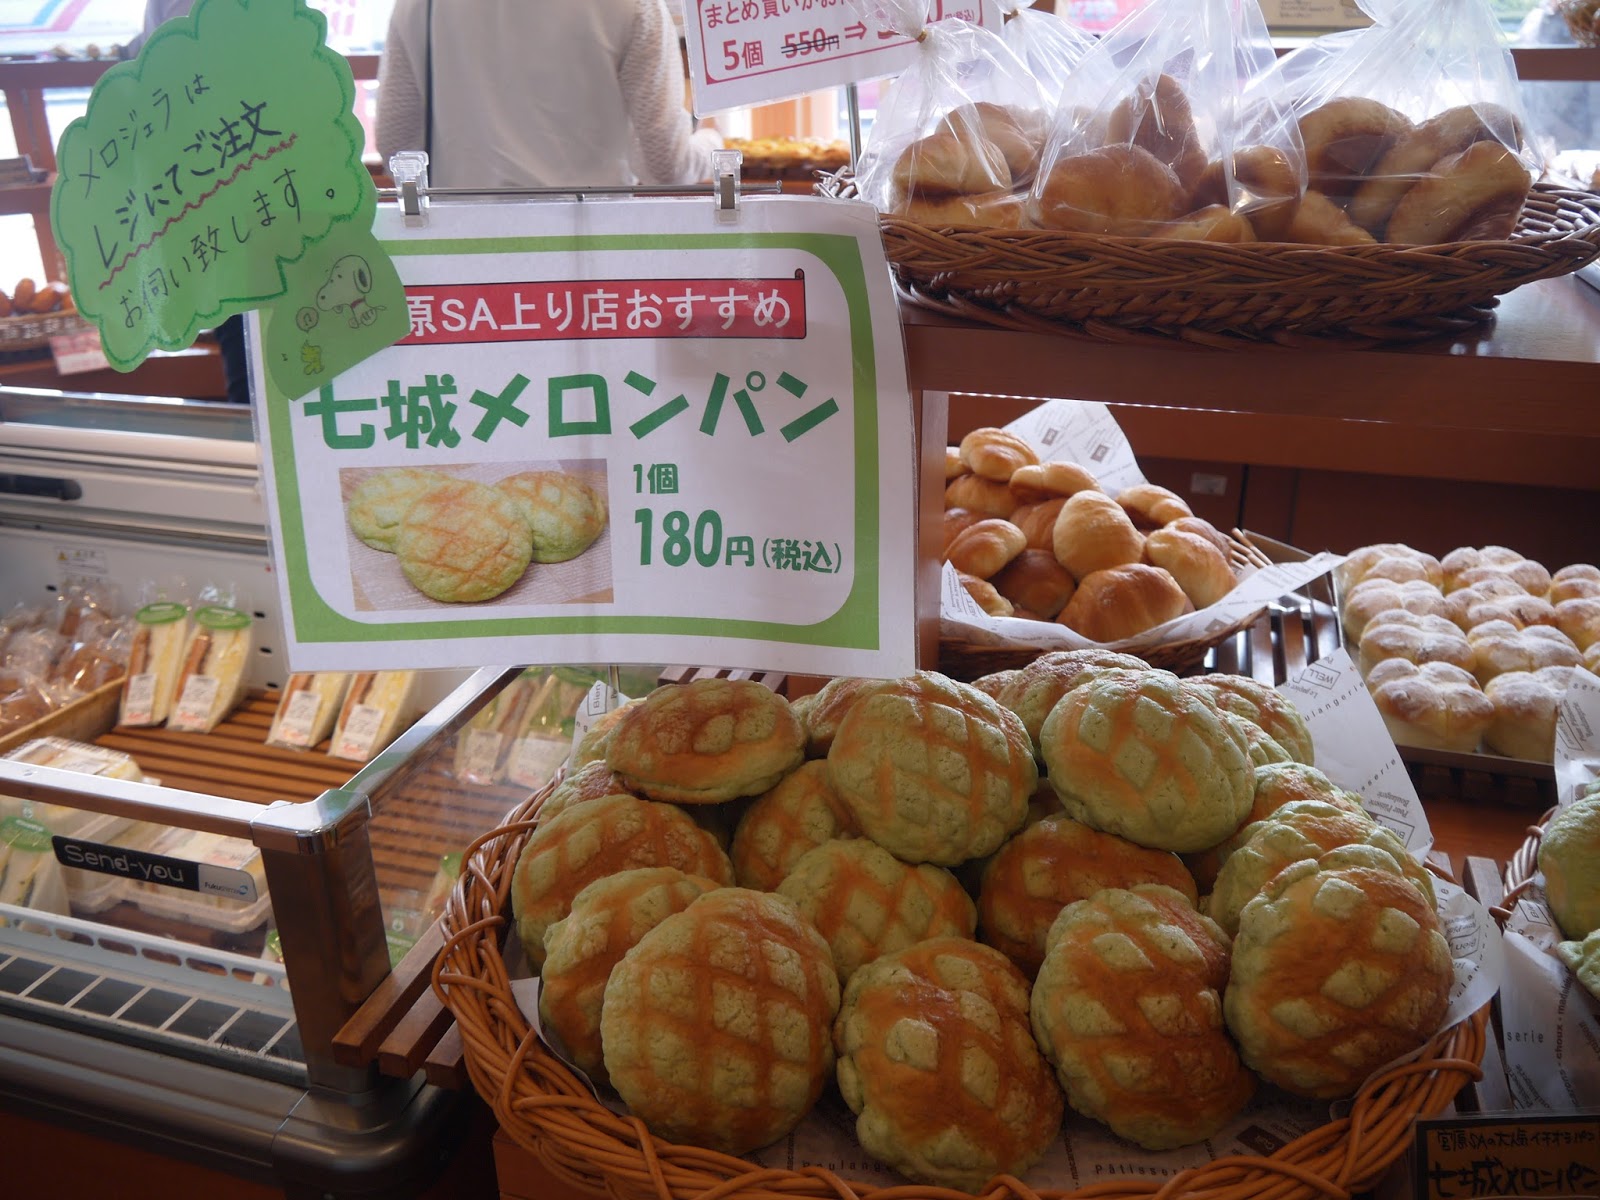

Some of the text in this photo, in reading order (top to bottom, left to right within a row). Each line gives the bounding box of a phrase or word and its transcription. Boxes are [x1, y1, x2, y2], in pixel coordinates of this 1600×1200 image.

[723, 40, 765, 71] 5個
[79, 73, 211, 199] メロジェラは
[94, 101, 282, 269] レジにてご注文
[408, 286, 791, 337] 原SA上り店おすすめ
[304, 370, 840, 450] 七城メロンパン
[633, 463, 679, 495] 1個
[634, 507, 842, 574] 180円(税込)
[64, 844, 185, 883] Send-you
